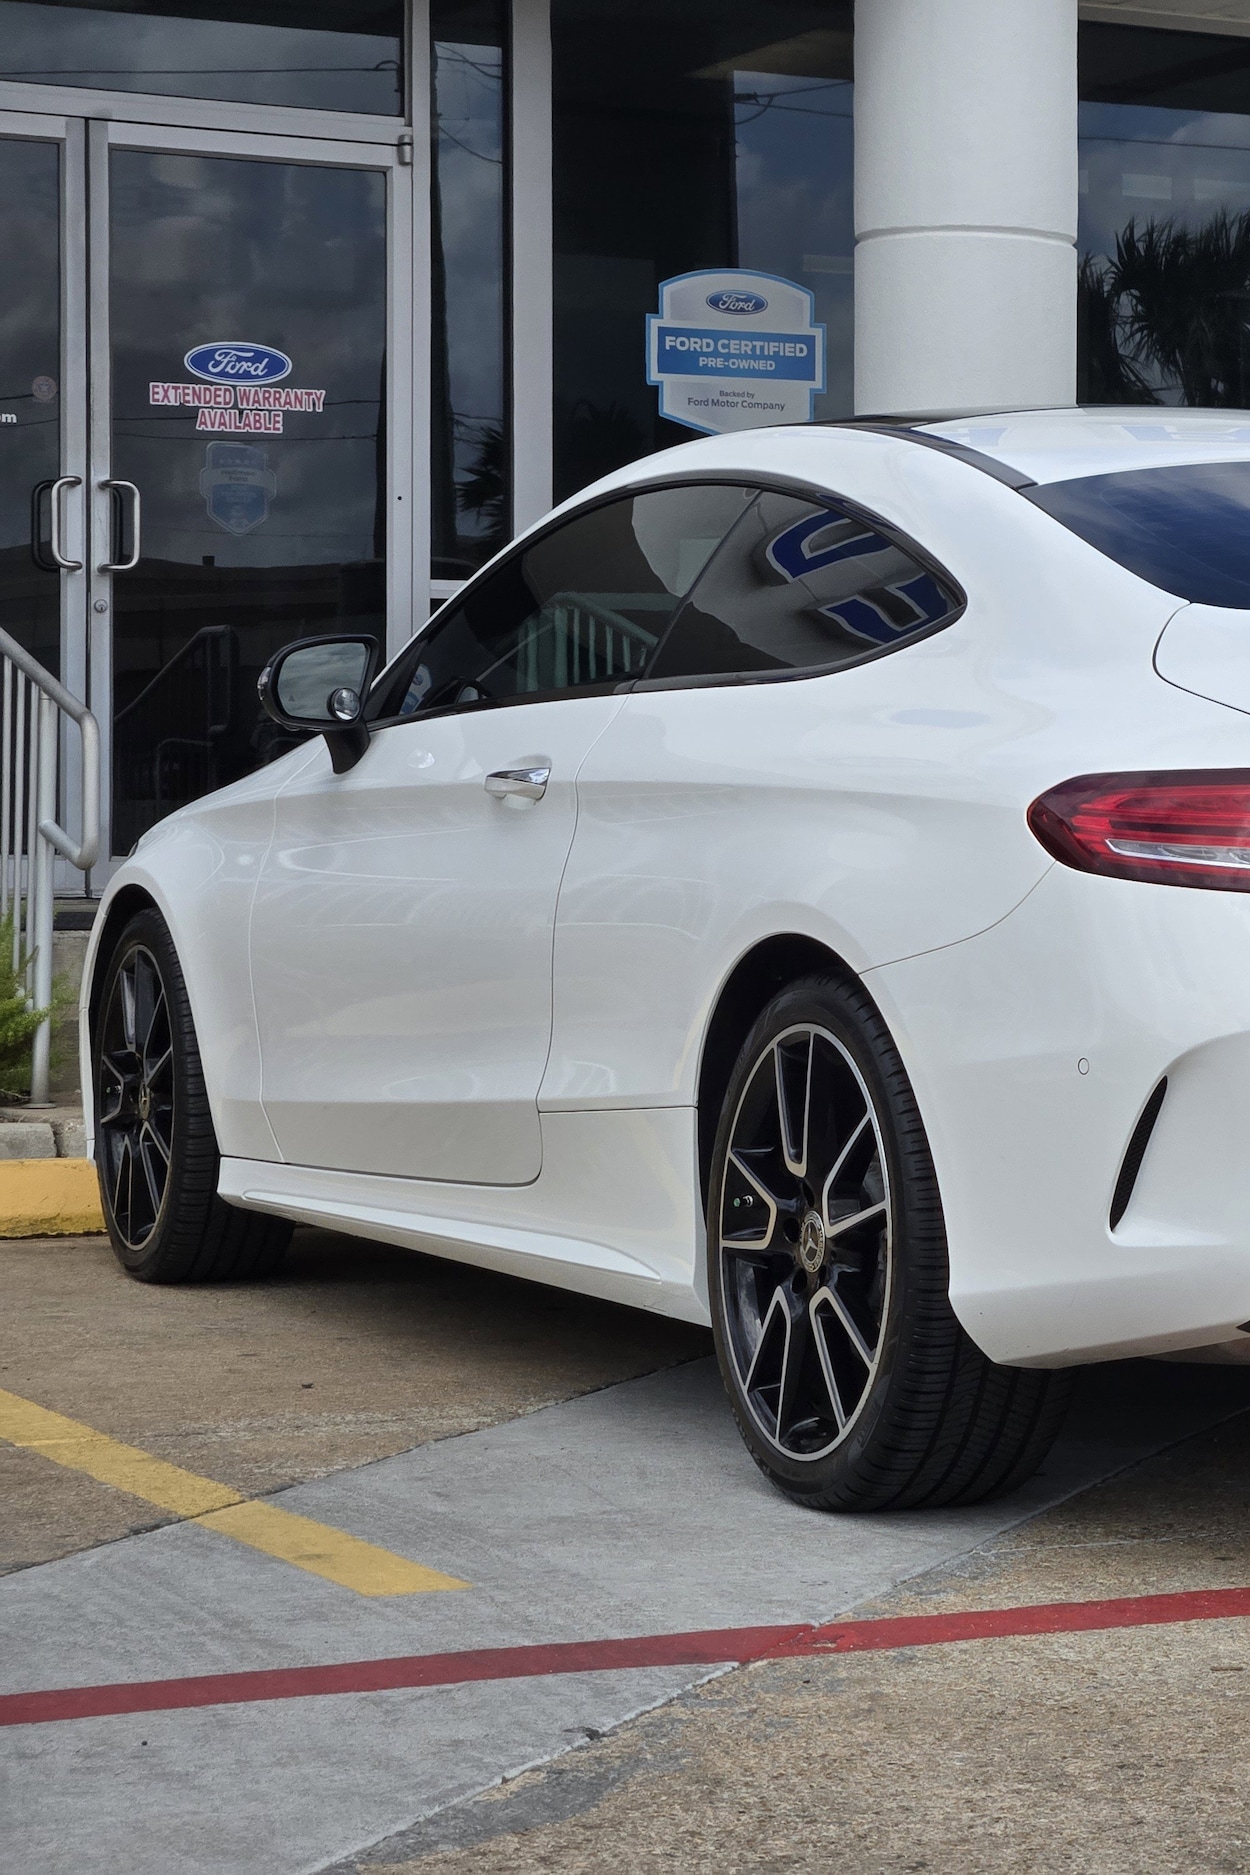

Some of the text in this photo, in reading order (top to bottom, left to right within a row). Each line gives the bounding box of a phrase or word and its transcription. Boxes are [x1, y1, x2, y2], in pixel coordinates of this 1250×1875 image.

[718, 293, 756, 311] Ford
[665, 336, 808, 357] FORD CERTIFIED
[208, 349, 269, 376] Ford
[699, 356, 776, 371] PRE-OWNED
[151, 383, 325, 411] EXTENDED WARRANTY
[687, 397, 786, 411] Ford Motor Company
[719, 390, 755, 399] Backed by
[197, 410, 282, 432] AVAILABLE
